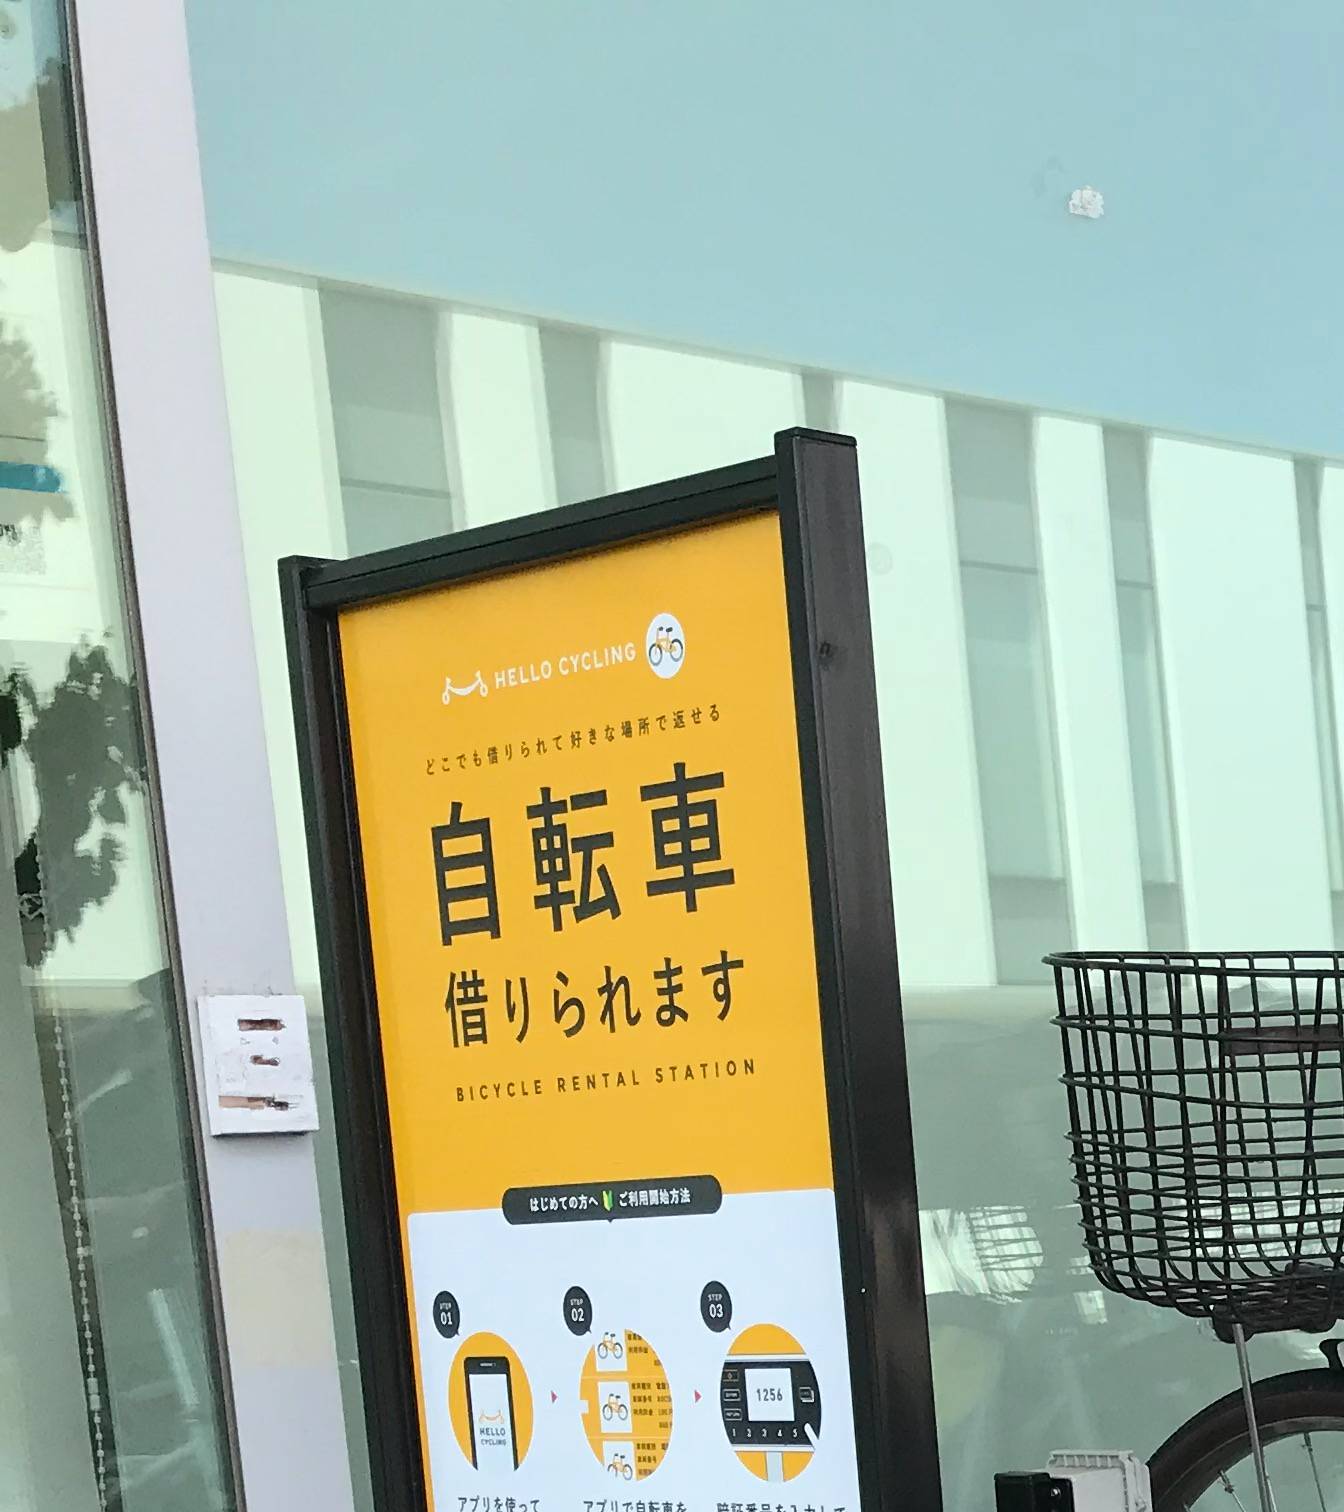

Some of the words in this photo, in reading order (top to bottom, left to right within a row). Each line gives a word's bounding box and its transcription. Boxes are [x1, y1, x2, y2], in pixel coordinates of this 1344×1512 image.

[495, 661, 552, 689] HELLO
[558, 642, 636, 676] CYCLING
[425, 704, 720, 776] どこでも借りられて好きな場所で返せる
[431, 762, 736, 947] 自転車
[445, 950, 745, 1049] 借りられます
[456, 1079, 543, 1102] BICYCLE
[557, 1070, 640, 1093] RENTAL
[655, 1059, 755, 1084] STATION
[529, 1194, 599, 1212] はじめての方へ
[619, 1187, 691, 1207] ご利用開始方法
[440, 1311, 453, 1326] 01
[571, 1307, 585, 1322] 02
[709, 1303, 723, 1318] 03
[756, 1388, 784, 1402] 1256
